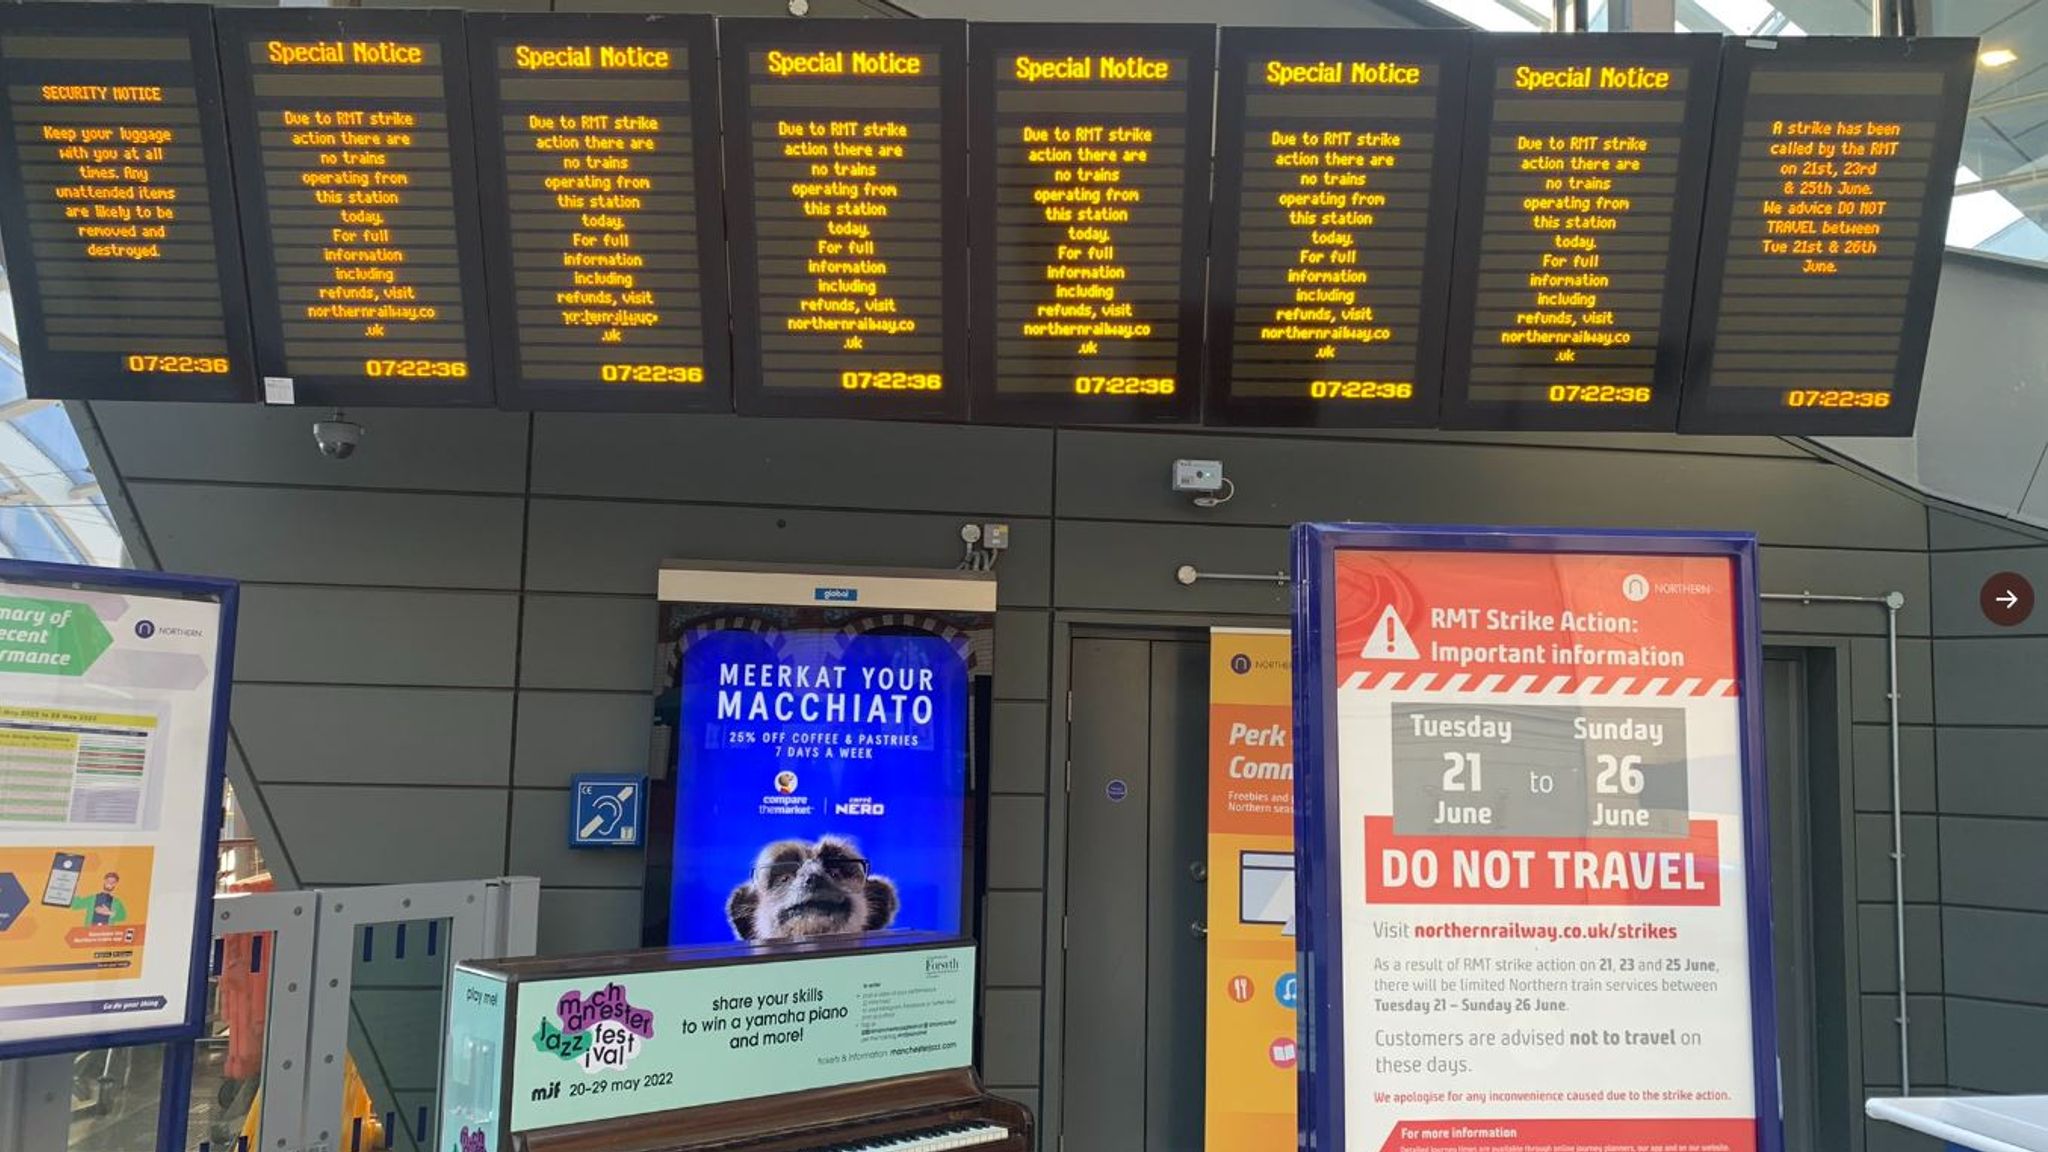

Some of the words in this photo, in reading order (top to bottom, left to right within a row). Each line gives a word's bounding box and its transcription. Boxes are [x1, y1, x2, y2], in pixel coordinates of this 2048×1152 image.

[268, 42, 346, 64] Special
[349, 42, 423, 64] Notice
[516, 47, 594, 69] Special
[598, 47, 671, 69] Notice
[768, 51, 846, 76] Special
[850, 52, 921, 76] Notice
[1016, 56, 1093, 82] Special
[1098, 57, 1169, 80] Notice
[1267, 61, 1343, 85] Special
[1350, 63, 1420, 85] Notice
[1516, 67, 1592, 90] Special
[1598, 67, 1670, 89] Notice
[43, 86, 107, 100] SECURITY
[43, 127, 79, 141] Keep
[80, 129, 112, 143] your
[120, 129, 171, 144] luggage
[1772, 122, 1784, 133] A
[1788, 123, 1832, 136] strike
[1836, 124, 1864, 136] has
[1864, 124, 1900, 136] been
[59, 147, 90, 160] with
[93, 149, 119, 162] you
[124, 149, 139, 160] at
[144, 148, 163, 160] all
[1771, 144, 1816, 156] called
[1816, 144, 1836, 157] by
[1840, 144, 1867, 156] the
[1867, 142, 1897, 156] RMT
[80, 167, 119, 180] times.
[123, 167, 149, 182] Any
[1781, 164, 1798, 175] on
[1803, 163, 1837, 176] 21st,
[1844, 162, 1878, 176] 23rd
[57, 187, 136, 199] unattended
[136, 187, 175, 200] items
[1783, 182, 1795, 195] &
[1801, 181, 1833, 195] 25th
[1839, 183, 1873, 195] June.
[67, 207, 90, 217] are
[95, 206, 134, 220] likely
[134, 208, 152, 218] to
[154, 208, 173, 219] be
[1763, 202, 1783, 215] We
[1786, 203, 1834, 215] advice
[1837, 201, 1857, 215] DO
[80, 226, 140, 238] removed
[140, 227, 165, 238] and
[1768, 220, 1815, 234] TRAVEL
[1821, 222, 1880, 235] between
[88, 245, 160, 258] destroyed.
[1764, 240, 1790, 253] Tue
[1793, 240, 1824, 254] 21st
[1827, 240, 1840, 253] &
[1844, 240, 1876, 254] 26th
[1804, 261, 1838, 273] June.
[129, 356, 228, 373] 07:22:36
[1787, 391, 1890, 407] 07:22:36
[1655, 583, 1710, 594] NORTHERN
[50, 609, 72, 628] of
[1432, 608, 1480, 628] RMT
[1487, 609, 1554, 631] Strike
[1561, 611, 1638, 633] Action:
[1432, 641, 1545, 667] Important
[1552, 644, 1684, 666] information
[720, 664, 846, 689] MEERKAT
[863, 668, 932, 690] YOUR
[718, 692, 933, 724] MACCHIATO
[1229, 722, 1286, 746] Perk
[1411, 714, 1511, 743] Tuesday
[1571, 717, 1663, 746] Sunday
[730, 732, 755, 742] 25%
[763, 732, 785, 743] OFF
[792, 733, 838, 744] COFFEE
[845, 734, 852, 744] &
[859, 734, 918, 746] PASTRIES
[776, 746, 781, 756] 7
[788, 747, 819, 757] DAYS
[826, 748, 833, 757] A
[840, 748, 872, 758] WEEK
[1443, 752, 1481, 791] 21
[1531, 772, 1553, 793] to
[1597, 754, 1647, 795] 26
[763, 796, 808, 805] compare
[1228, 802, 1271, 812] Northern
[836, 804, 884, 815] NERO
[1435, 801, 1491, 824] June
[1593, 804, 1649, 826] June
[1383, 849, 1437, 888] DO
[1454, 850, 1535, 888] NOT
[1548, 851, 1704, 889] TRAVEL
[1374, 922, 1409, 938] Visit
[1415, 922, 1677, 942] northernrailway.co.uk/strikes
[466, 988, 482, 1005] play
[712, 996, 752, 1011] share
[758, 993, 788, 1010] your
[792, 988, 824, 1004] skills
[1375, 999, 1430, 1014] Tuesday
[1434, 999, 1446, 1011] 21
[1462, 998, 1511, 1014] Sunday
[1516, 998, 1531, 1011] 26
[1535, 999, 1569, 1012] June.
[682, 1019, 697, 1034] to
[702, 1016, 726, 1032] win
[731, 1018, 740, 1028] a
[746, 1009, 805, 1030] yamaha
[809, 1006, 848, 1024] piano
[730, 1032, 759, 1048] and
[763, 1028, 804, 1045] more!
[1376, 1030, 1463, 1046] Customers
[1469, 1033, 1495, 1045] are
[1501, 1029, 1564, 1045] advised
[1570, 1030, 1598, 1045] not
[1603, 1030, 1620, 1045] to
[1625, 1029, 1676, 1045] travel
[1681, 1033, 1701, 1045] on
[1376, 1057, 1421, 1073] these
[1427, 1056, 1472, 1076] days.
[532, 1081, 561, 1101] mjf
[612, 1078, 640, 1091] may
[644, 1072, 674, 1087] 2022
[1374, 1092, 1391, 1103] We
[1394, 1092, 1444, 1104] apologise
[1448, 1091, 1463, 1101] for
[1466, 1093, 1486, 1104] any
[1490, 1093, 1564, 1101] inconvenience
[1567, 1091, 1604, 1101] caused
[1607, 1091, 1626, 1100] due
[1629, 1091, 1640, 1100] to
[1643, 1090, 1660, 1100] the
[1662, 1090, 1693, 1100] strike
[1695, 1090, 1731, 1100] action.
[1402, 1128, 1419, 1139] For
[1420, 1130, 1449, 1139] more
[1452, 1127, 1516, 1137] information
